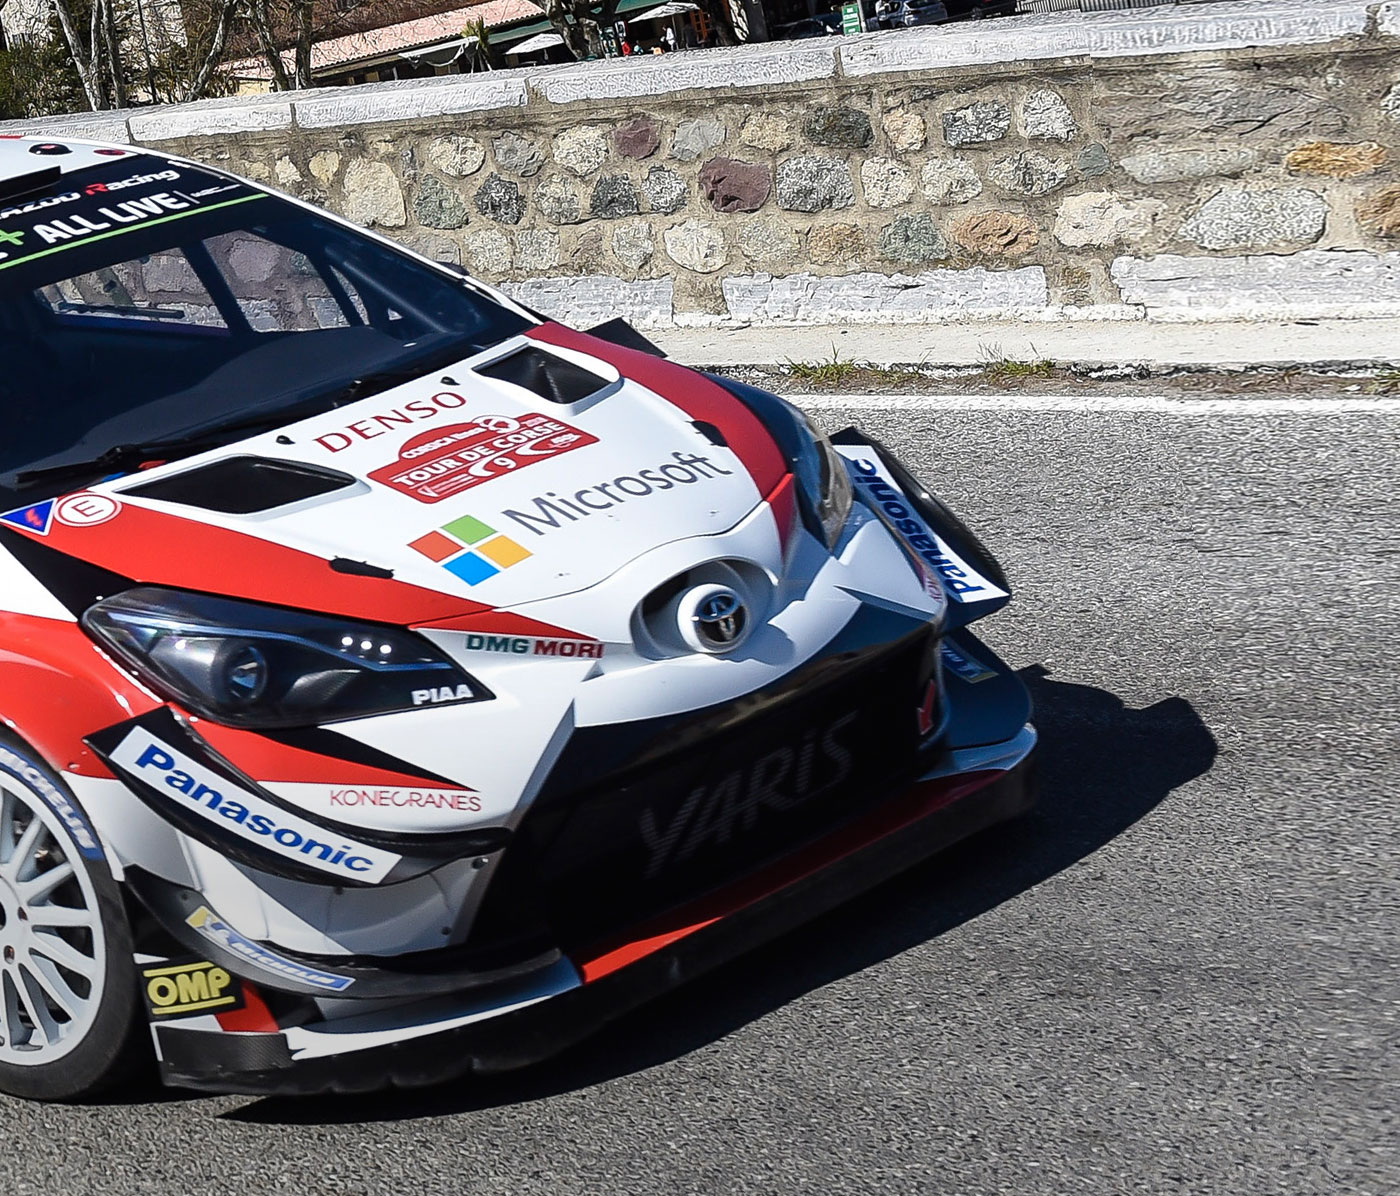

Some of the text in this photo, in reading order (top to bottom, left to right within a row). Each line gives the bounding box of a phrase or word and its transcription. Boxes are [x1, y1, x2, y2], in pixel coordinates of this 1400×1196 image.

[85, 168, 181, 196] Racing
[33, 214, 111, 244] ALL
[98, 190, 191, 224] LIVE
[313, 390, 467, 454] DENSO
[392, 458, 464, 487] TOUR
[464, 444, 495, 462] DE
[494, 421, 567, 450] CORSE
[493, 457, 517, 469] 9
[71, 500, 104, 517] E
[501, 450, 734, 536] Microsoft
[853, 458, 987, 596] Panasonic
[466, 634, 605, 659] DMG MORI
[411, 684, 474, 705] PIAA
[134, 744, 375, 873] Panasonic
[330, 789, 482, 812] KONECRANES
[639, 709, 860, 880] YARIS
[230, 941, 337, 985] MICHELIN
[147, 967, 232, 1006] OMP
